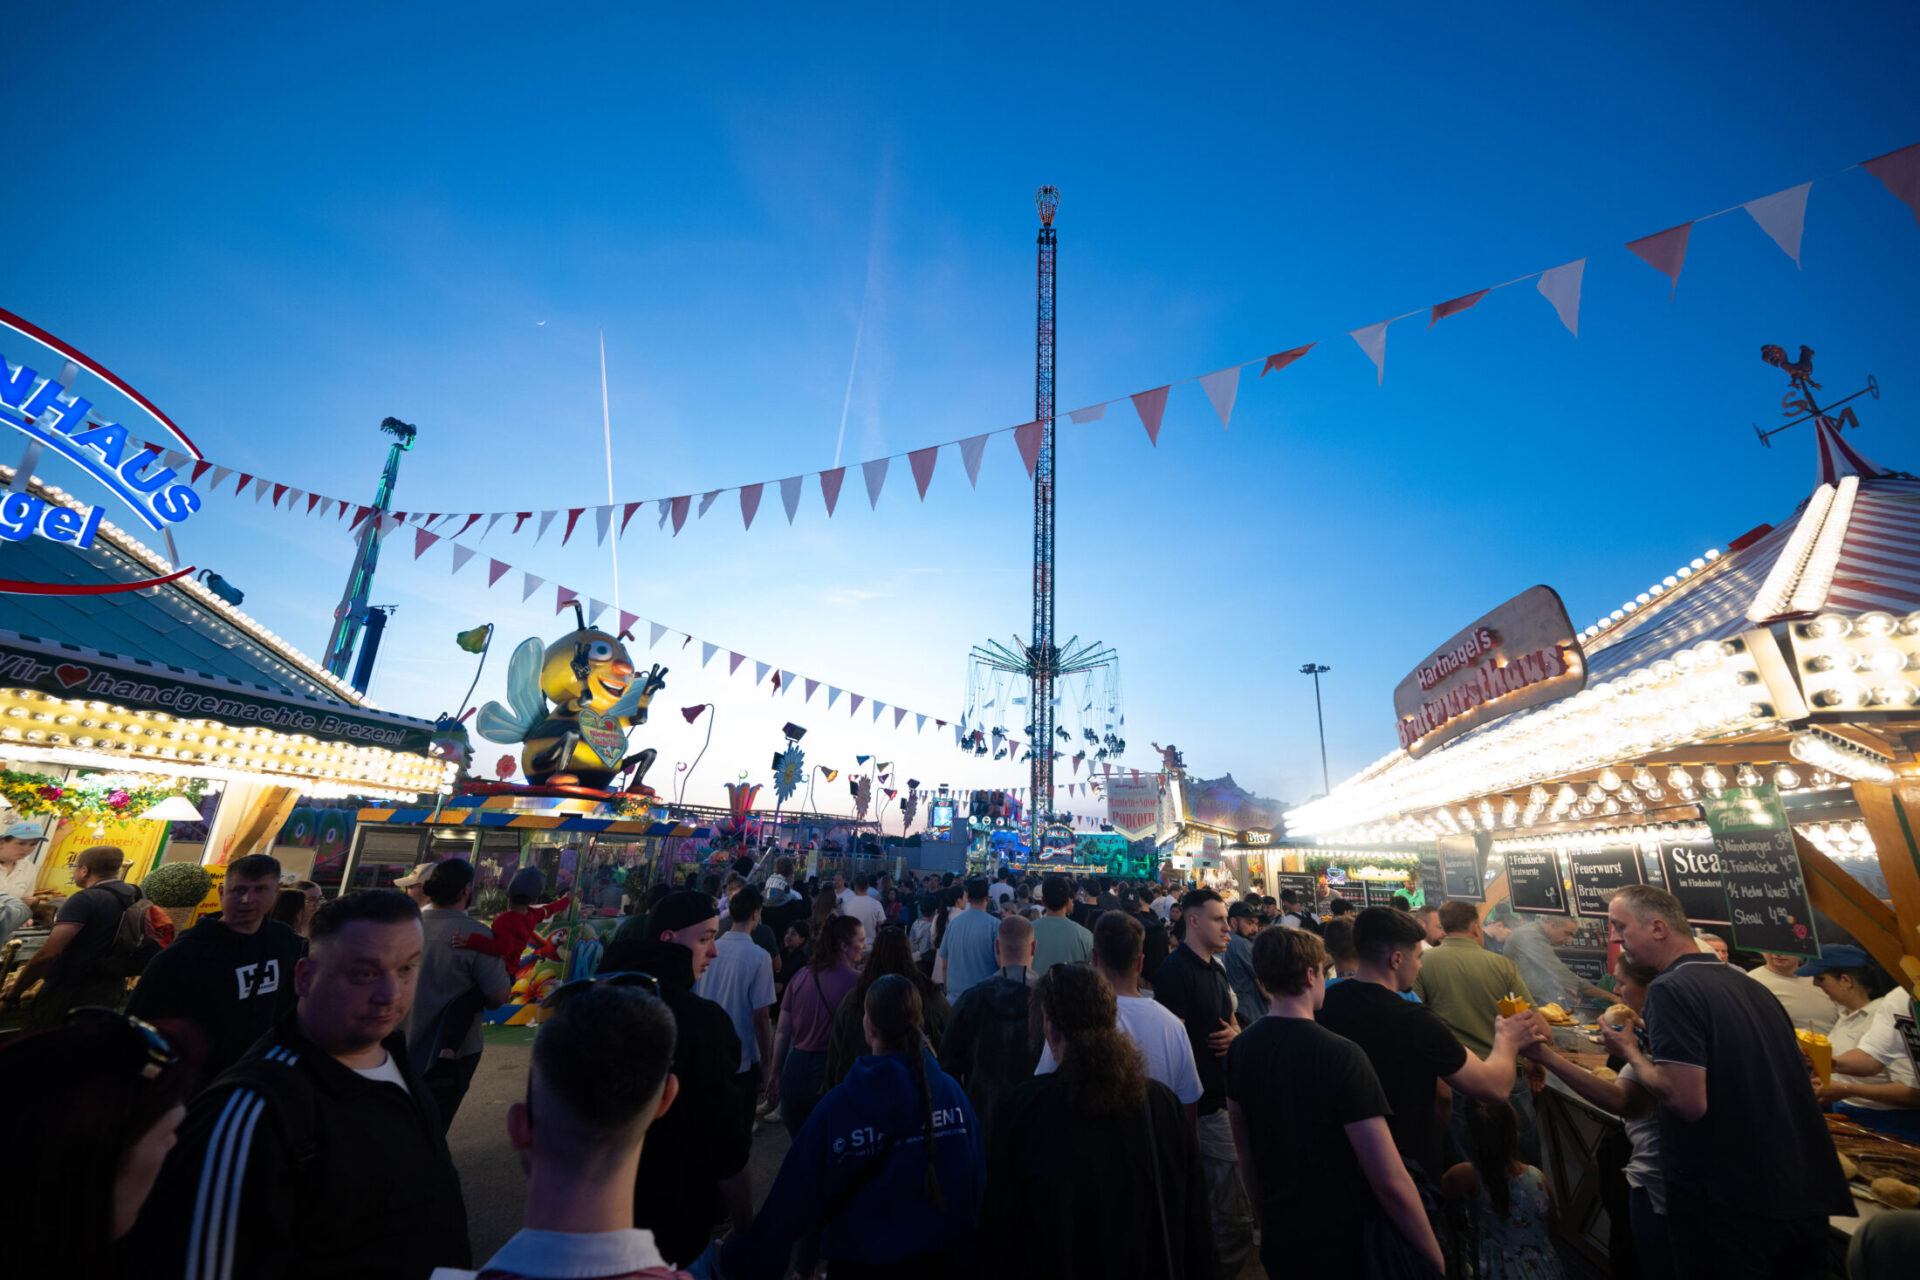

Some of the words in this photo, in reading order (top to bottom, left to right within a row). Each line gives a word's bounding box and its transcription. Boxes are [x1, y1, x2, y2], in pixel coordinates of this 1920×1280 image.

[1416, 628, 1493, 690] Hartnagel's
[1395, 645, 1566, 749] Bratwursthaus
[87, 671, 316, 730] handgemachte
[318, 714, 407, 746] Brezen!
[1112, 810, 1155, 830] Popcorn
[1247, 832, 1271, 844] Bier
[1715, 839, 1724, 852] 3
[1724, 839, 1772, 858] Nürnberger
[1573, 861, 1623, 876] Feuerwurst
[1672, 847, 1721, 875] Stea
[1721, 861, 1731, 874] 2
[1679, 879, 1687, 888] im
[1688, 879, 1722, 888] Fladenbrot
